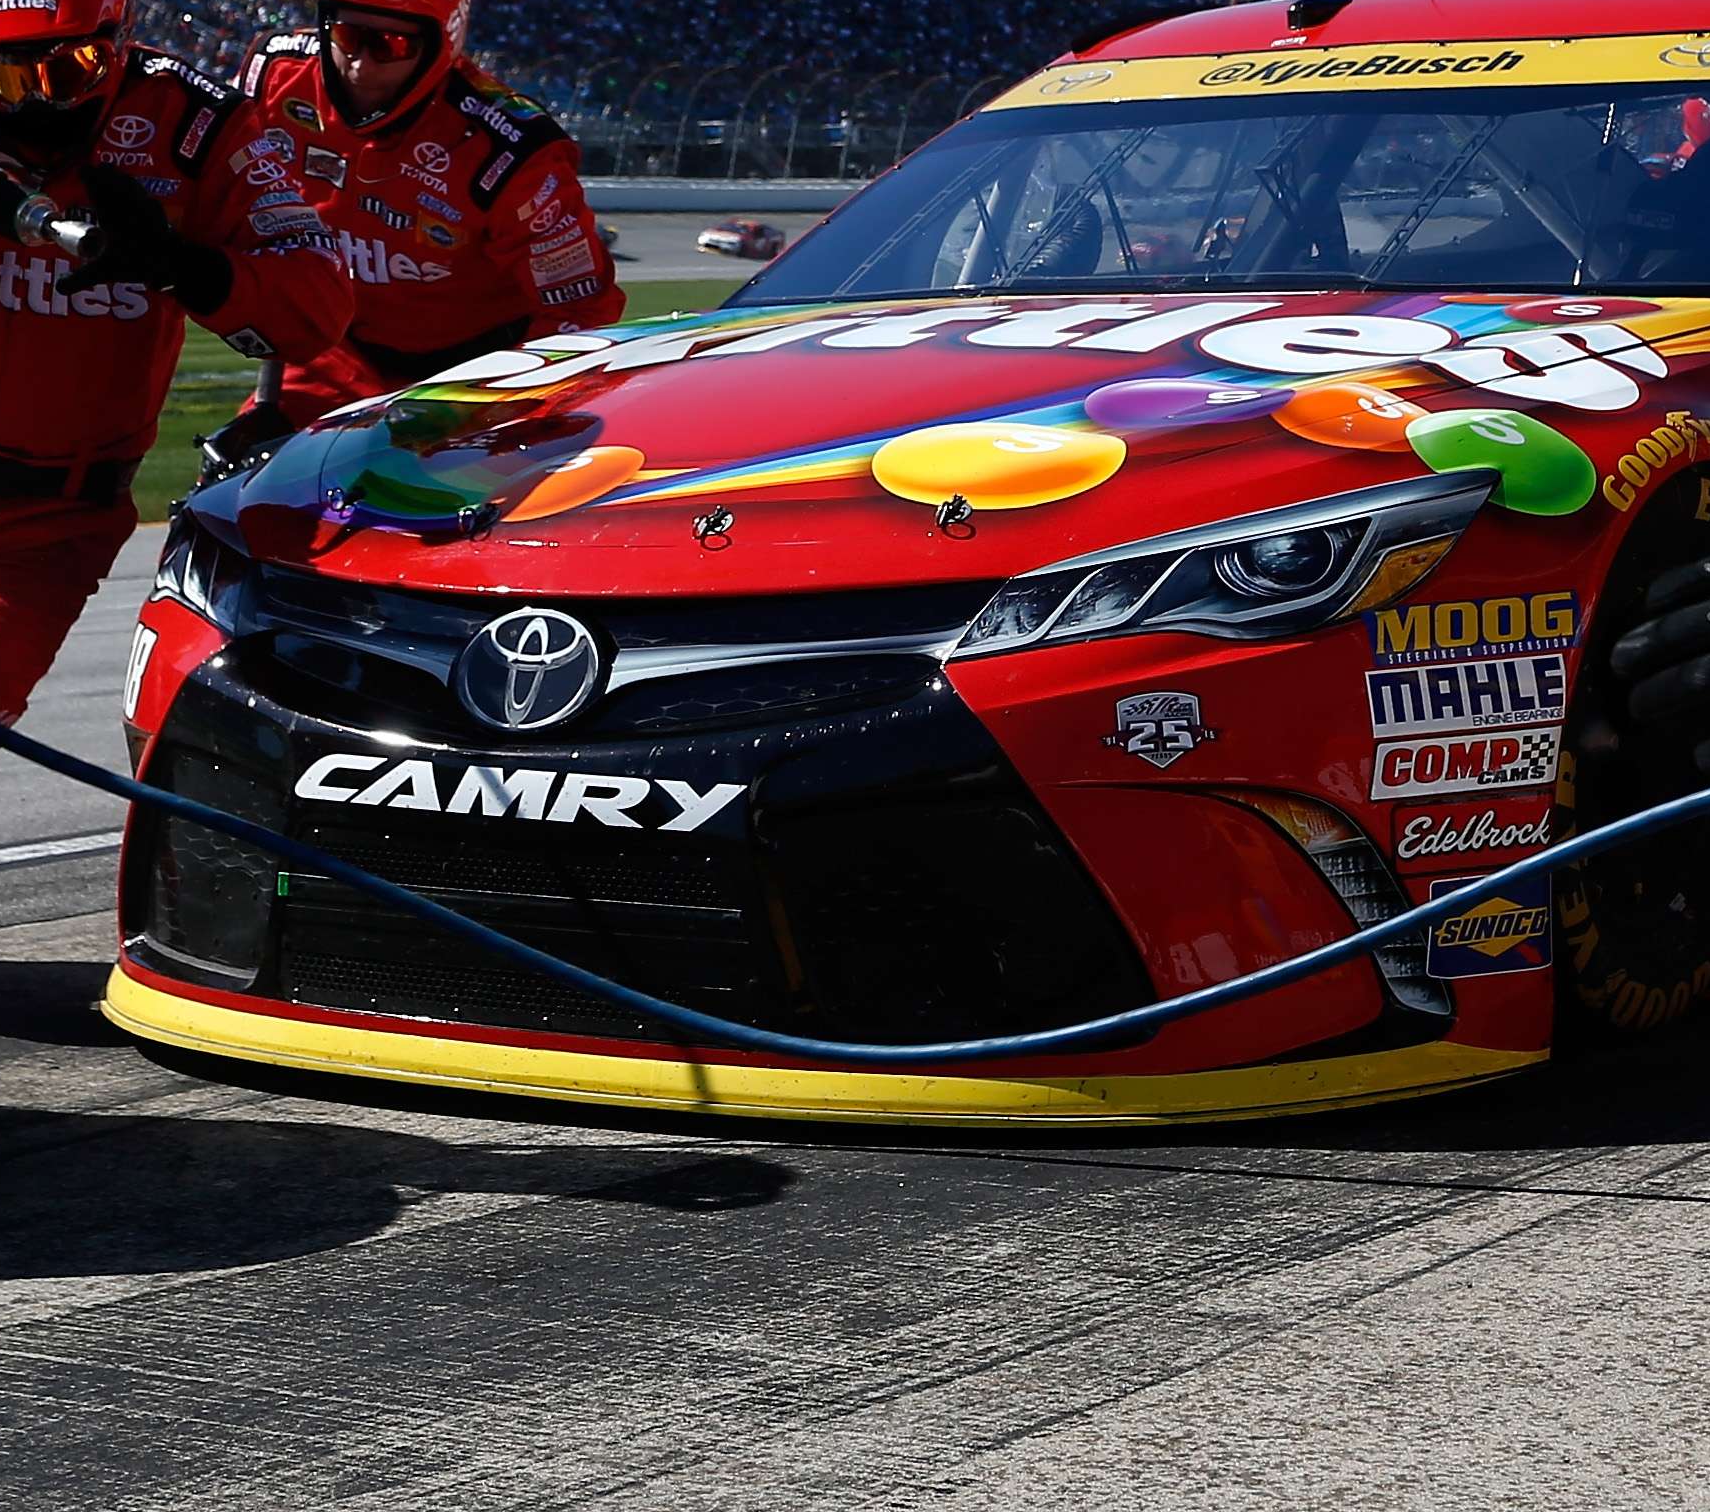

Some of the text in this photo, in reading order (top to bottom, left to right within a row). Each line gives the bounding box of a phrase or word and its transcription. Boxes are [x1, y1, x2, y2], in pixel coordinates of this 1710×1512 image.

[266, 33, 322, 55] Skittle
[1198, 49, 1524, 87] @KyleBusch
[460, 94, 523, 143] Skittles
[96, 149, 155, 167] OYOTA
[1375, 591, 1575, 656] MOOG
[1389, 648, 1456, 666] STEERING
[1483, 637, 1569, 656] SUSPENSION
[1369, 656, 1564, 726] MAHLE
[1128, 719, 1194, 753] 25
[1473, 707, 1564, 727] ENGINE BEARINGS
[1381, 738, 1520, 787] COMP
[1476, 765, 1547, 785] CAMS
[294, 753, 749, 832] CAMRY
[1398, 808, 1551, 860] Edelbrock
[1438, 907, 1548, 947] SUNOCO
